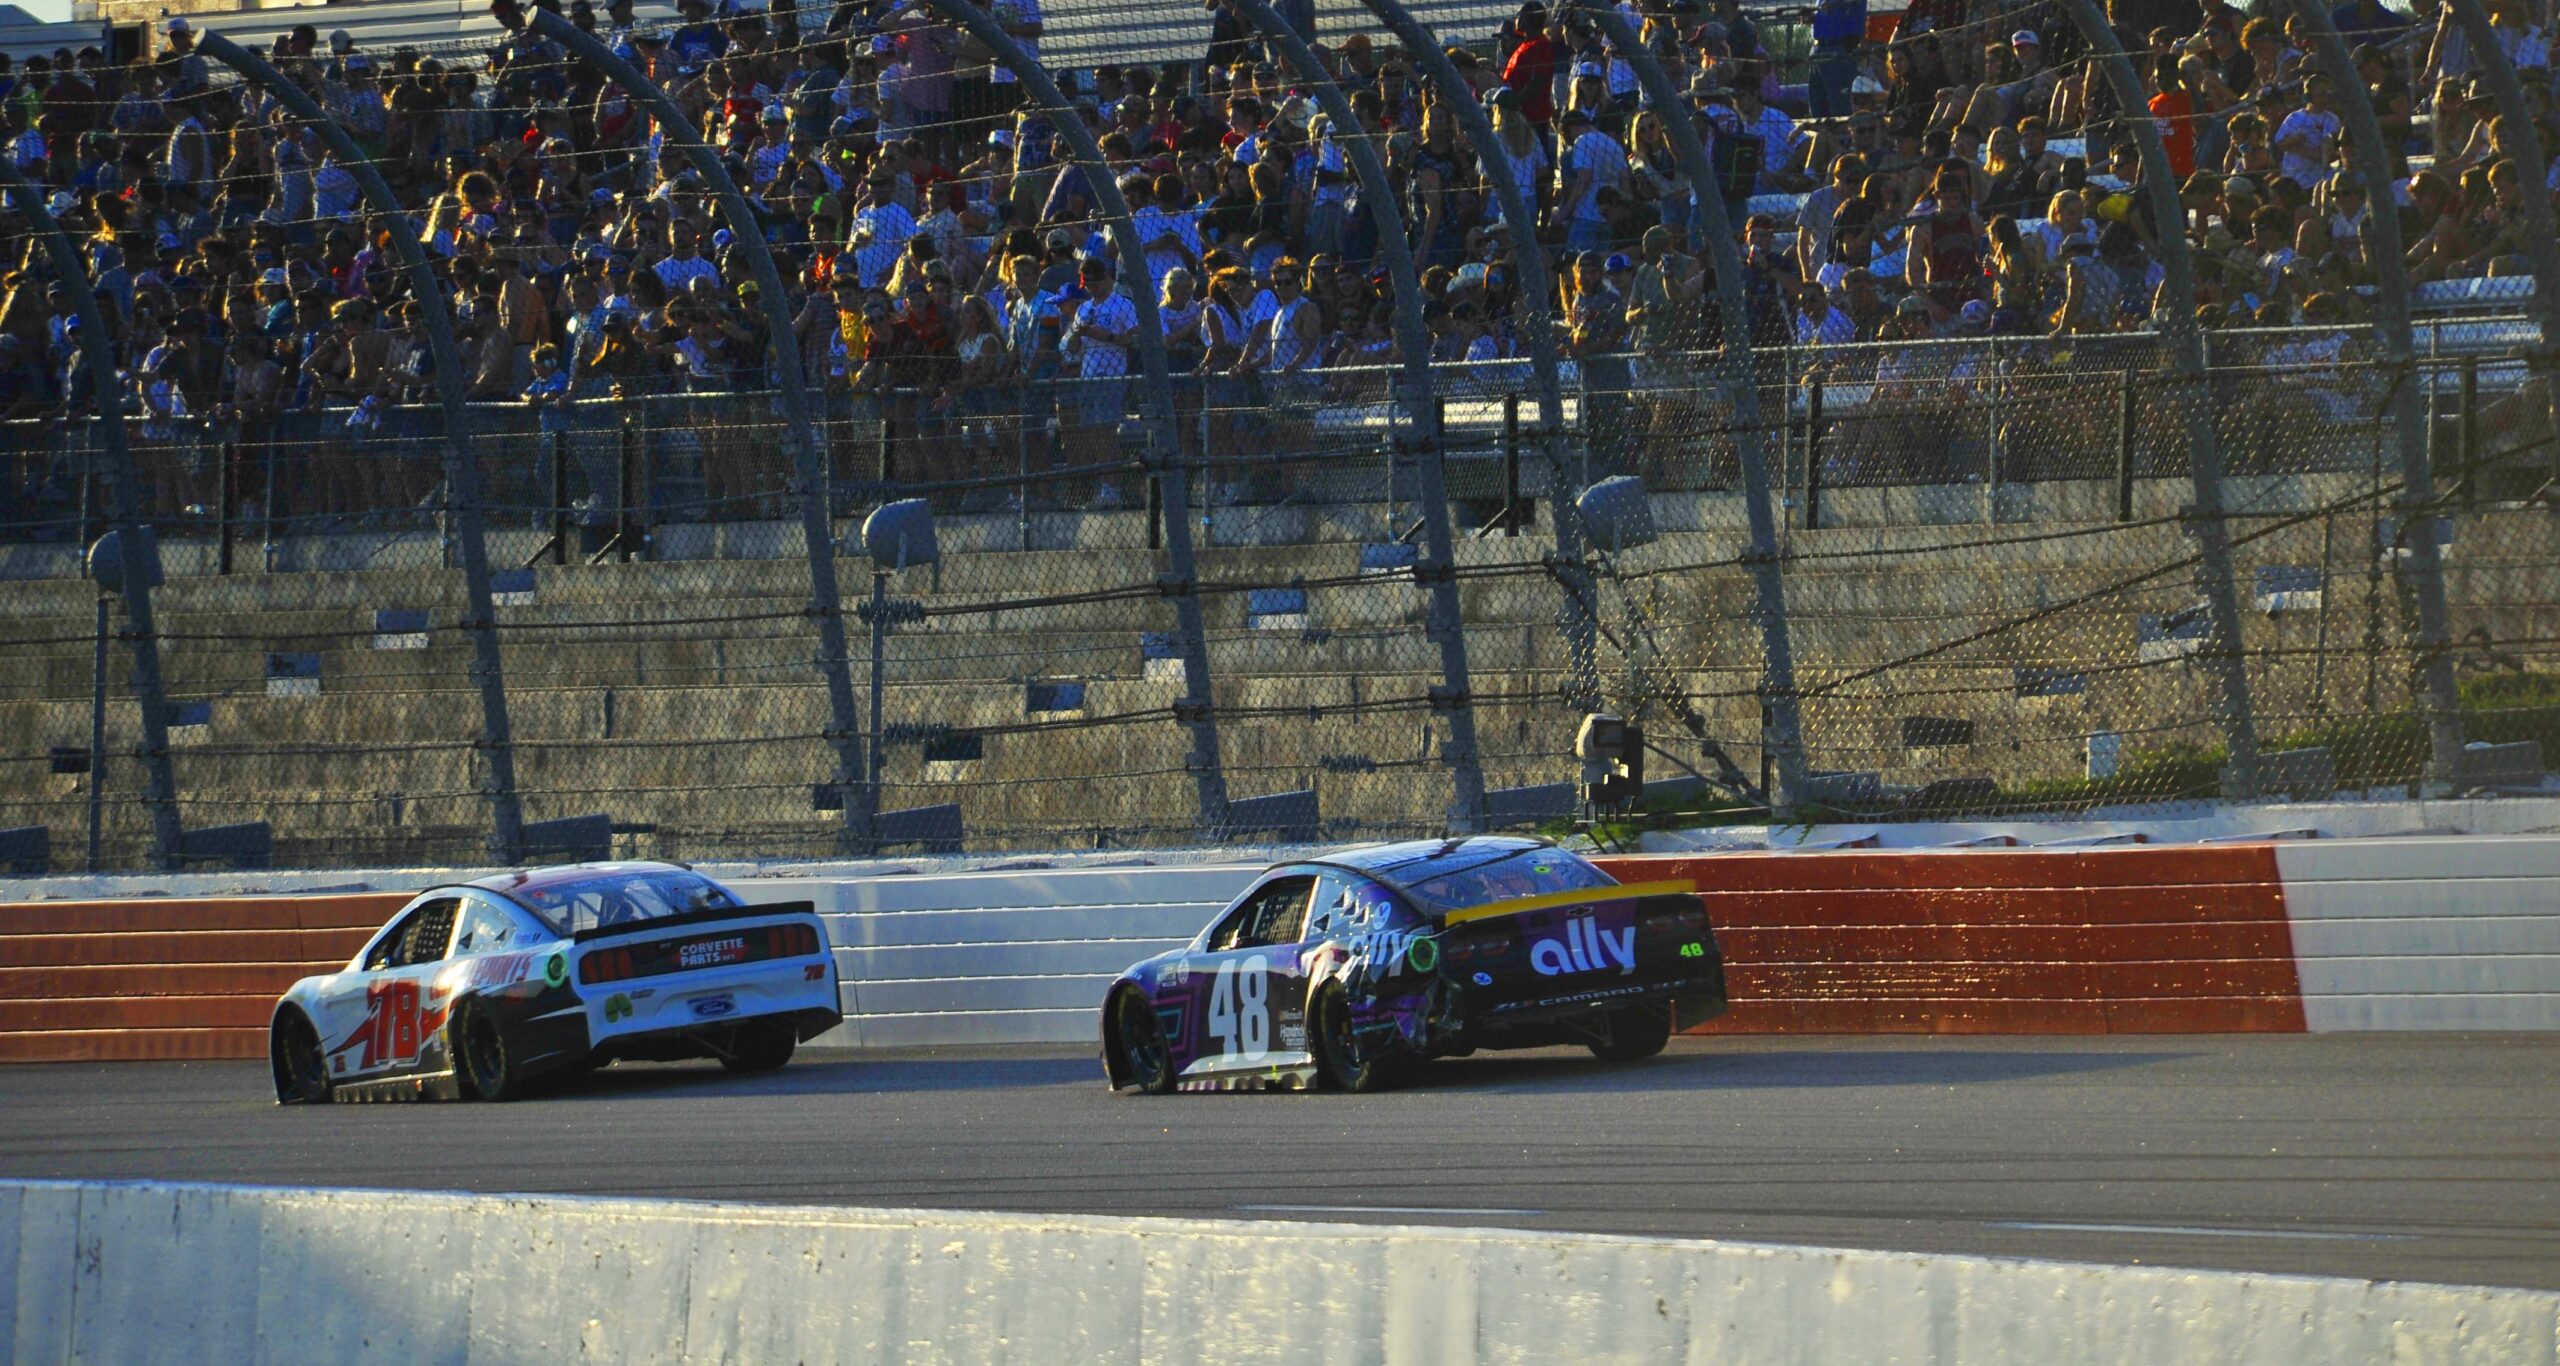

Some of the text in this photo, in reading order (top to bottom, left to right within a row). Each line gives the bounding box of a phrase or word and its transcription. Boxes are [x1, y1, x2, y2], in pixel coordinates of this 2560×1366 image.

[680, 937, 744, 956] CORVETTE
[1530, 916, 1636, 976] ally
[1680, 943, 1704, 957] 48
[1208, 953, 1270, 1063] 48
[1539, 985, 1645, 1006] CAMARO
[363, 977, 421, 1069] 78
